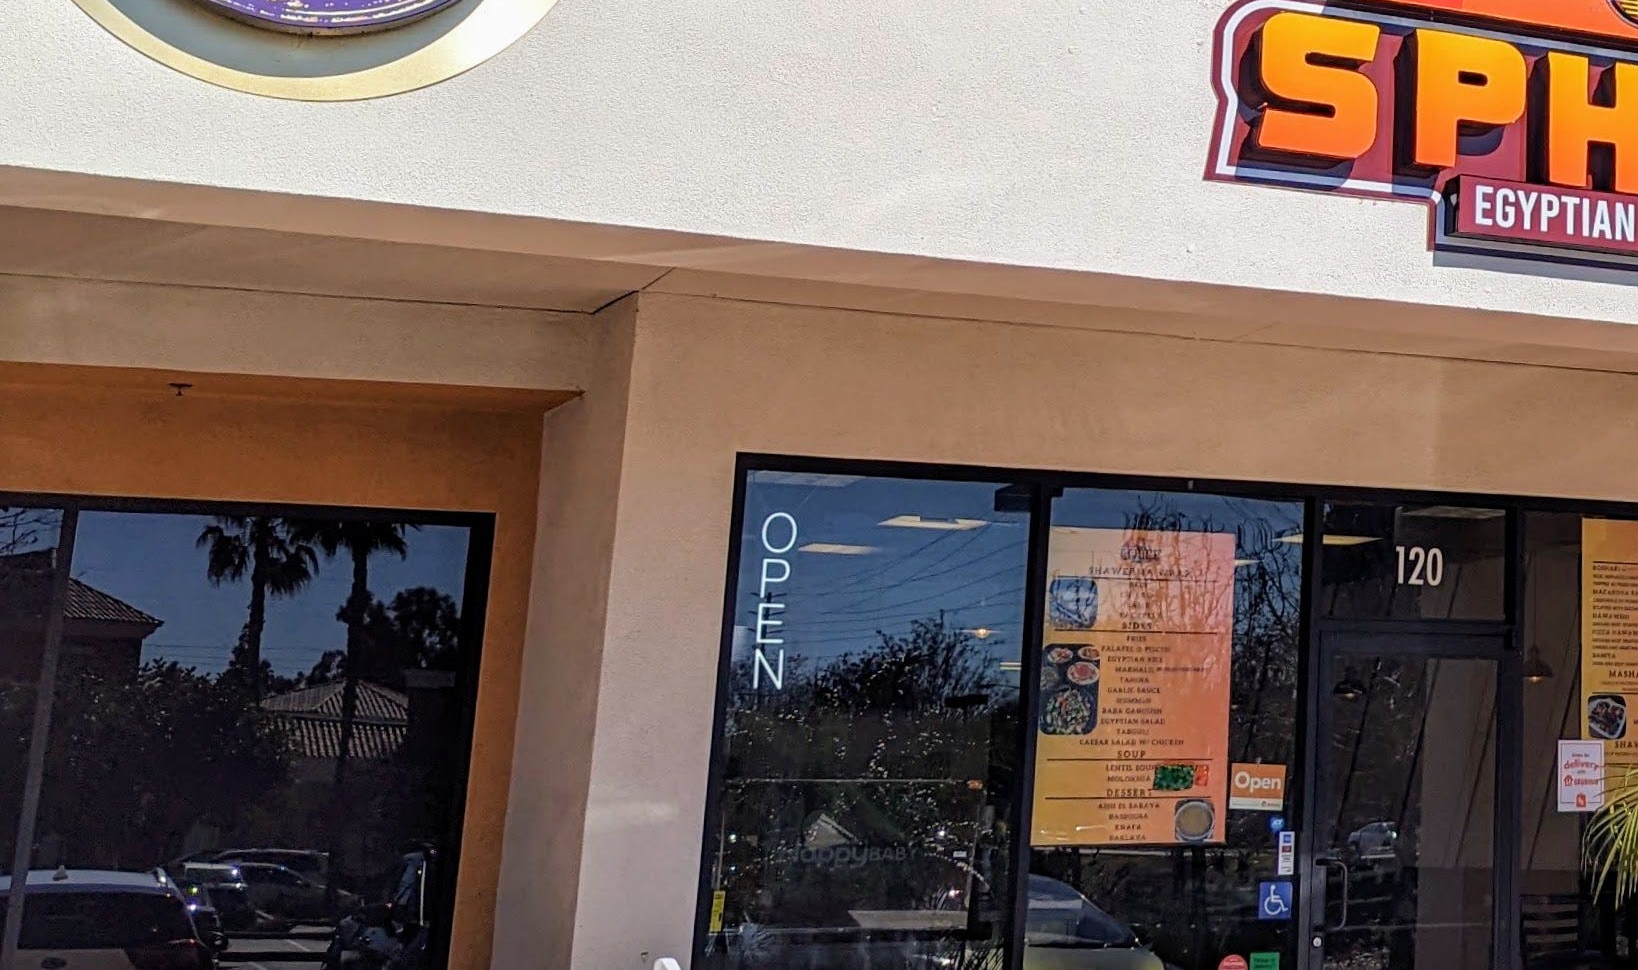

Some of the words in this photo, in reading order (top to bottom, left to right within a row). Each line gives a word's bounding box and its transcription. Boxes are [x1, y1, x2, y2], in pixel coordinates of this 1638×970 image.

[1474, 186, 1636, 244] EGYPTIAN
[1395, 545, 1443, 587] 120
[752, 511, 798, 691] OPEN
[1117, 750, 1146, 758] SOUP
[1564, 758, 1599, 771] delivery
[1235, 771, 1282, 792] Open
[1106, 788, 1153, 797] DESSERT
